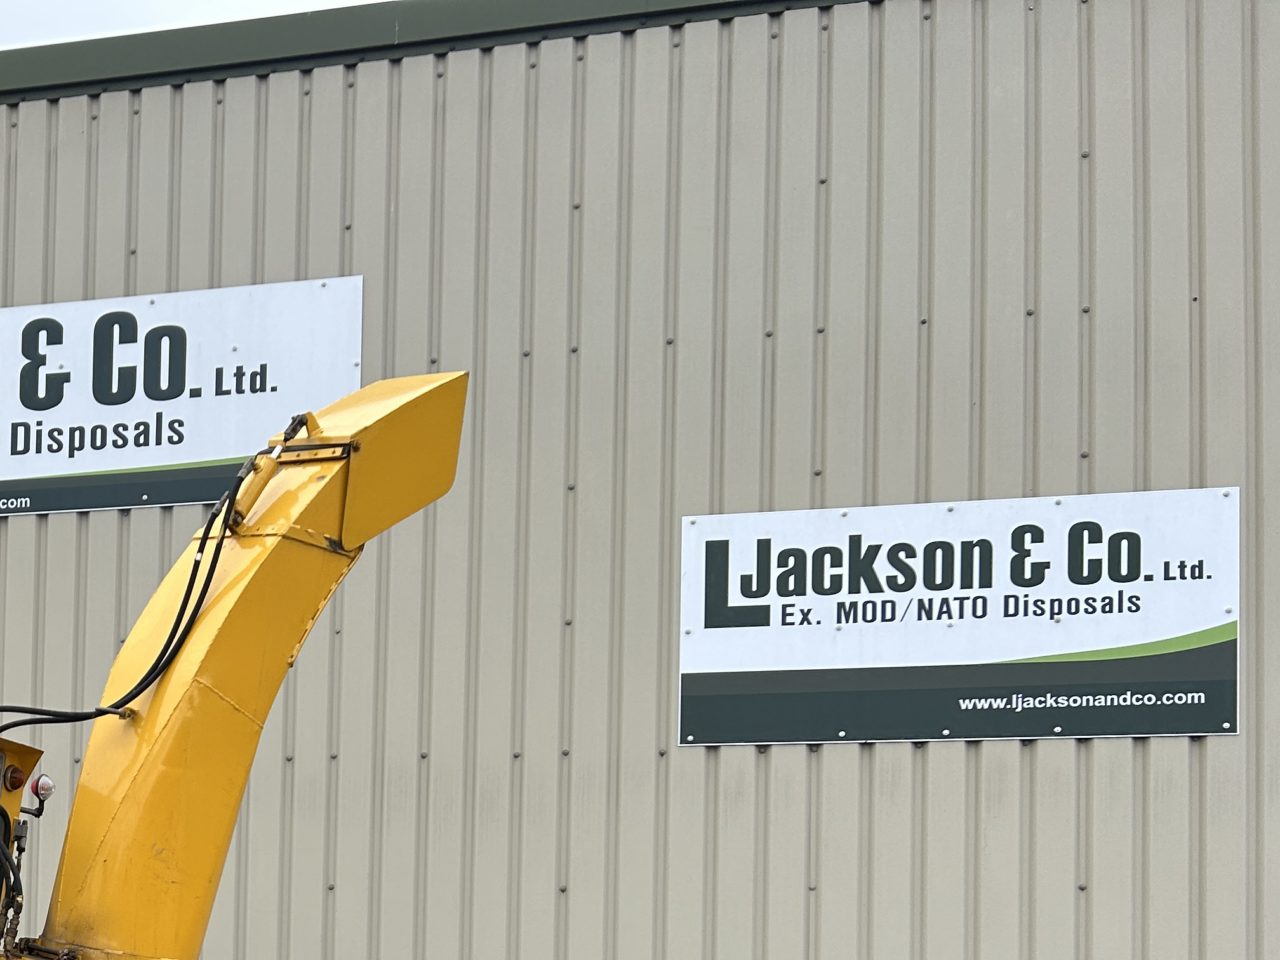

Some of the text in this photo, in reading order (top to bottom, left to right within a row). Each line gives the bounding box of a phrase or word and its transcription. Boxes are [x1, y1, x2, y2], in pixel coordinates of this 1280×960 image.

[19, 317, 71, 412] &
[91, 311, 202, 406] Co.
[214, 363, 278, 397] Ltd.
[10, 411, 185, 459] Disposals
[1009, 524, 1051, 588] &
[1067, 520, 1154, 586] Co.
[1163, 559, 1212, 581] Ltd.
[780, 589, 1141, 627] Ex. MOD/NATO Disposals
[958, 690, 1206, 713] www.ljacksonandco.com
